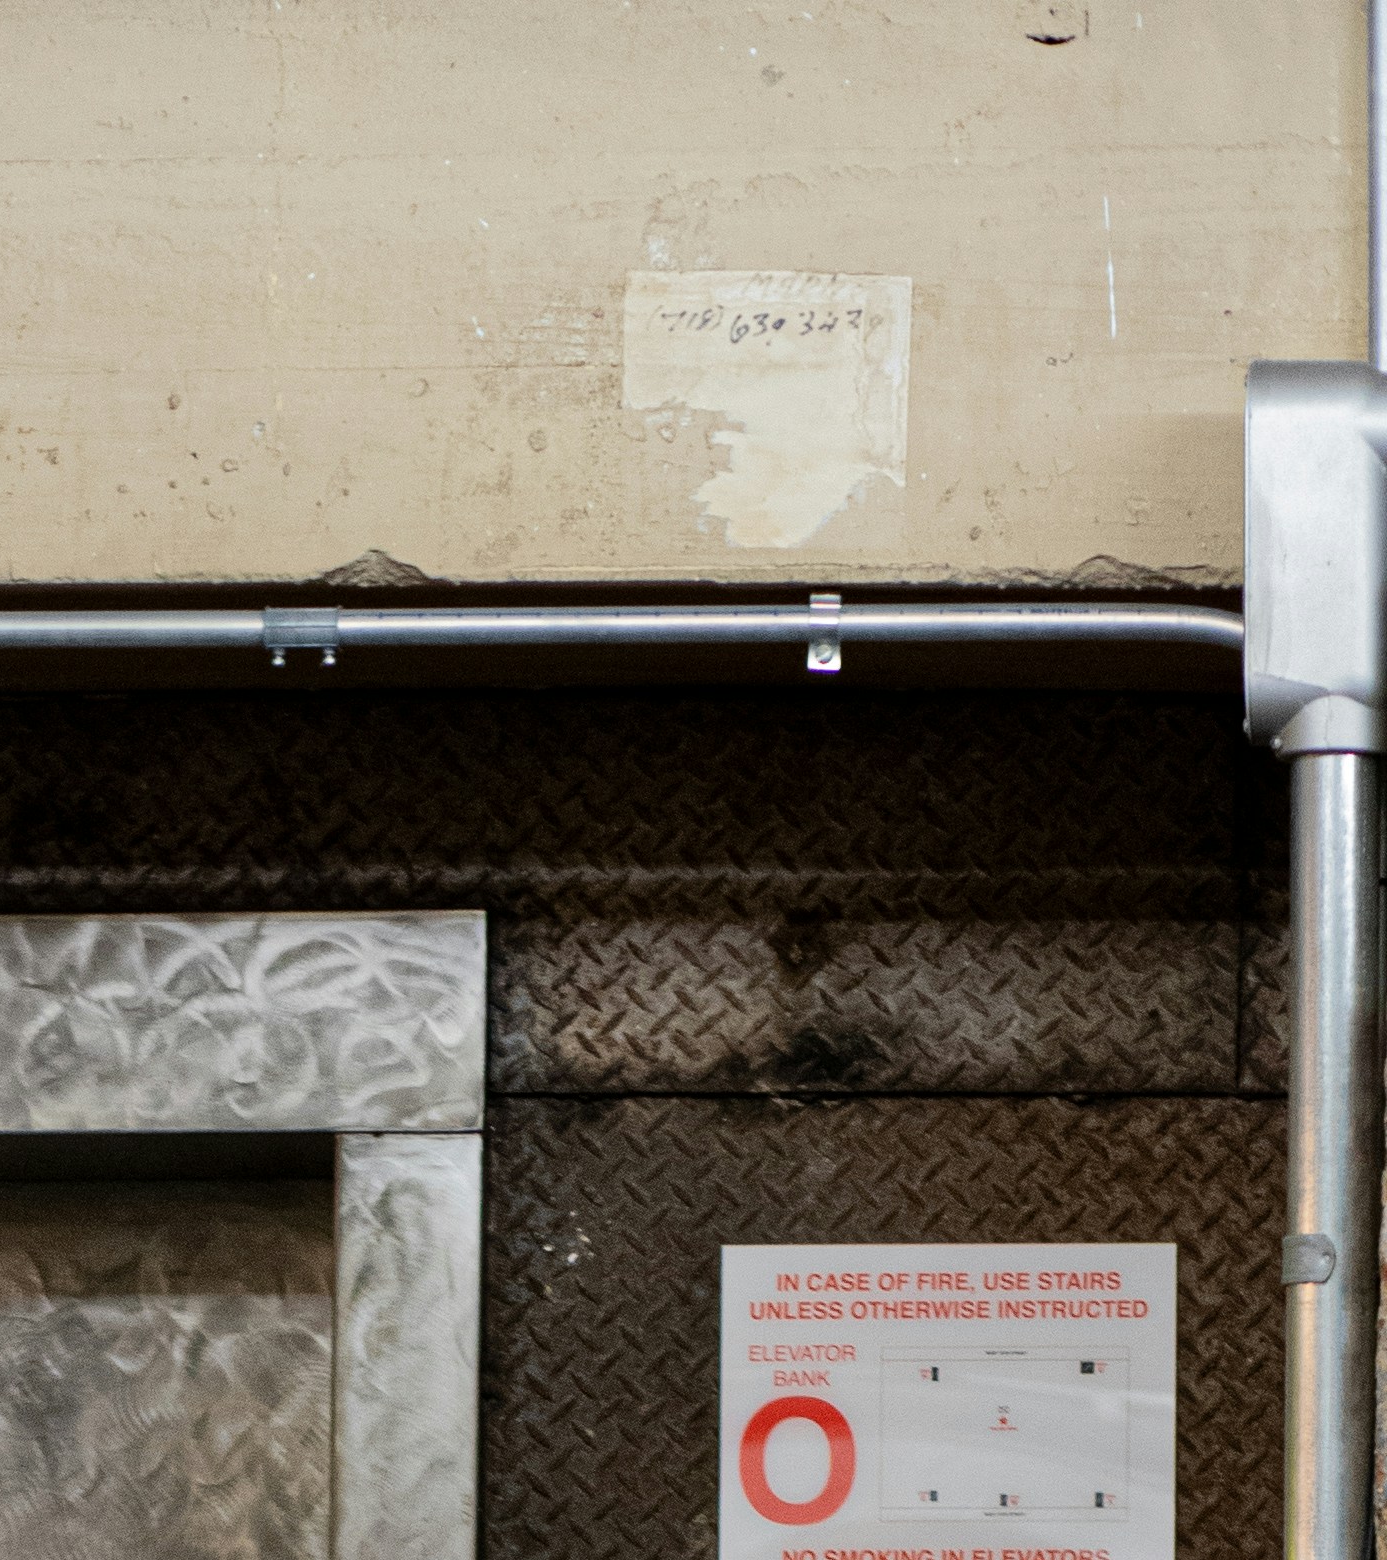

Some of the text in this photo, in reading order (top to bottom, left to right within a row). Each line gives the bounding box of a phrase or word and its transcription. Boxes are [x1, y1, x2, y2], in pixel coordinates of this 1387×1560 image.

[777, 1271, 1122, 1295] IN CASE OF FIRE, USE STAIRS
[749, 1300, 1150, 1321] UNLESS OTHERWISE INSTRUCTED
[748, 1345, 857, 1363] ELEVATOR
[774, 1370, 831, 1388] BANK
[739, 1395, 857, 1527] O
